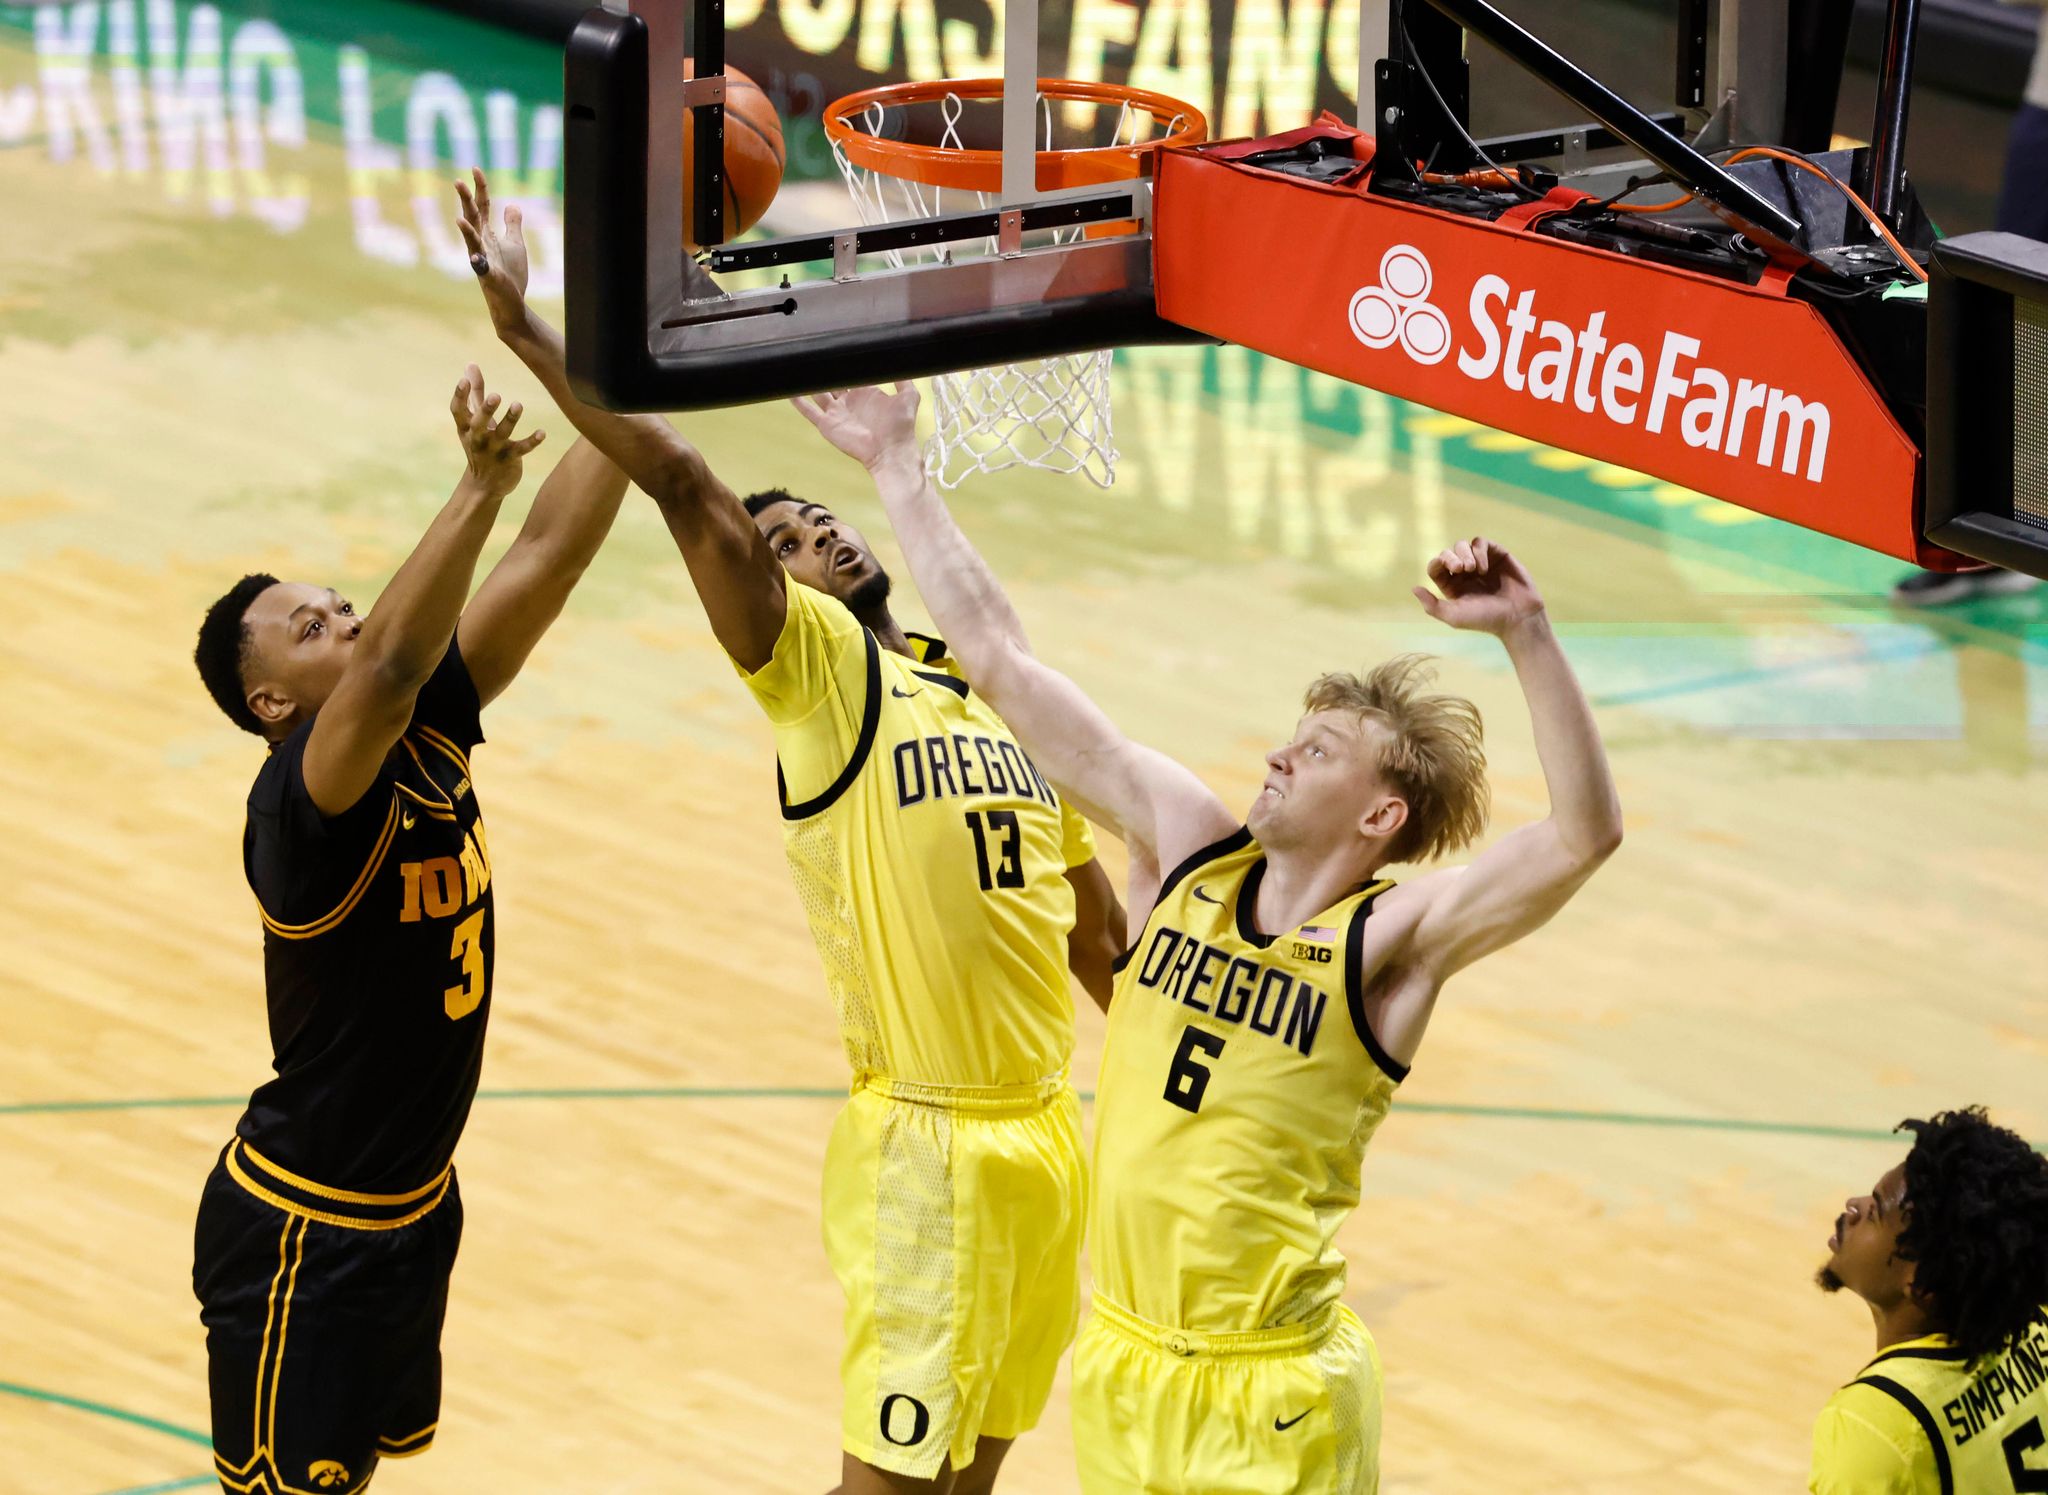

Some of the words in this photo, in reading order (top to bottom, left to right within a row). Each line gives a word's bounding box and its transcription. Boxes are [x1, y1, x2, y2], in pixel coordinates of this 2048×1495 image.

[893, 734, 1059, 810] OREGON
[400, 816, 492, 922] IOW
[965, 810, 1025, 891] 13
[444, 908, 485, 1021] 3
[1137, 926, 1329, 1058] OREGON
[1163, 1024, 1227, 1114] 6
[880, 1393, 929, 1447] O
